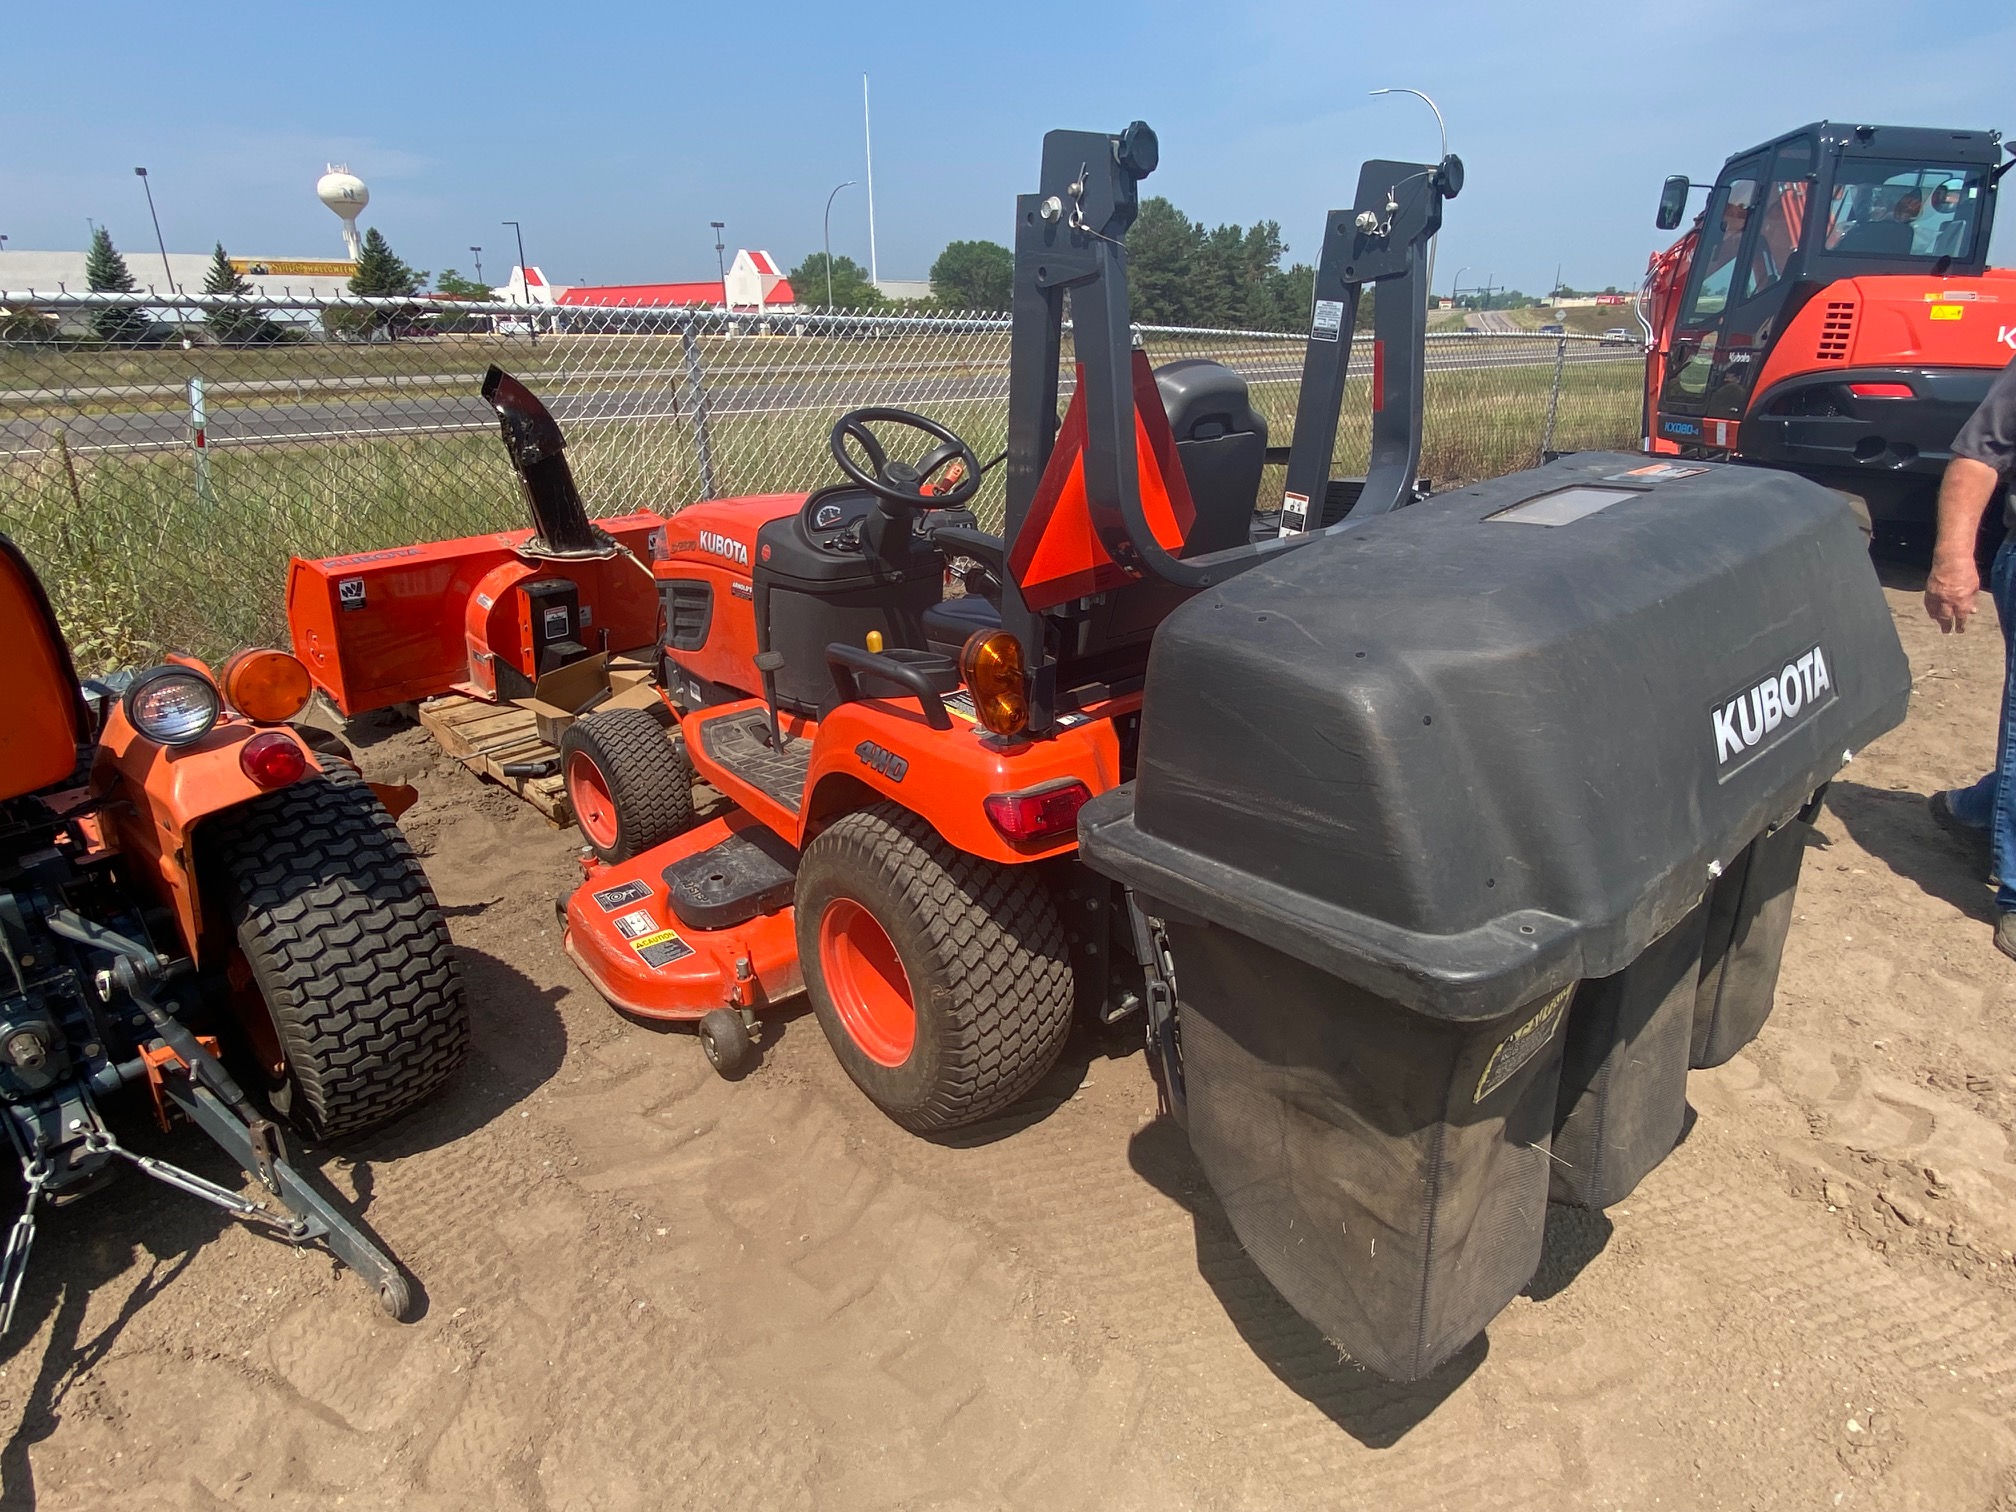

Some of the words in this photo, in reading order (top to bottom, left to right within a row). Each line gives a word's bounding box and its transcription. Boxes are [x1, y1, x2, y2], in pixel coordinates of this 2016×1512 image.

[1729, 352, 1750, 362] Kubota
[699, 530, 748, 566] KUBOTA
[1712, 646, 1830, 764] KUBOTA
[855, 740, 909, 783] 4WD
[642, 932, 675, 946] CAUTION
